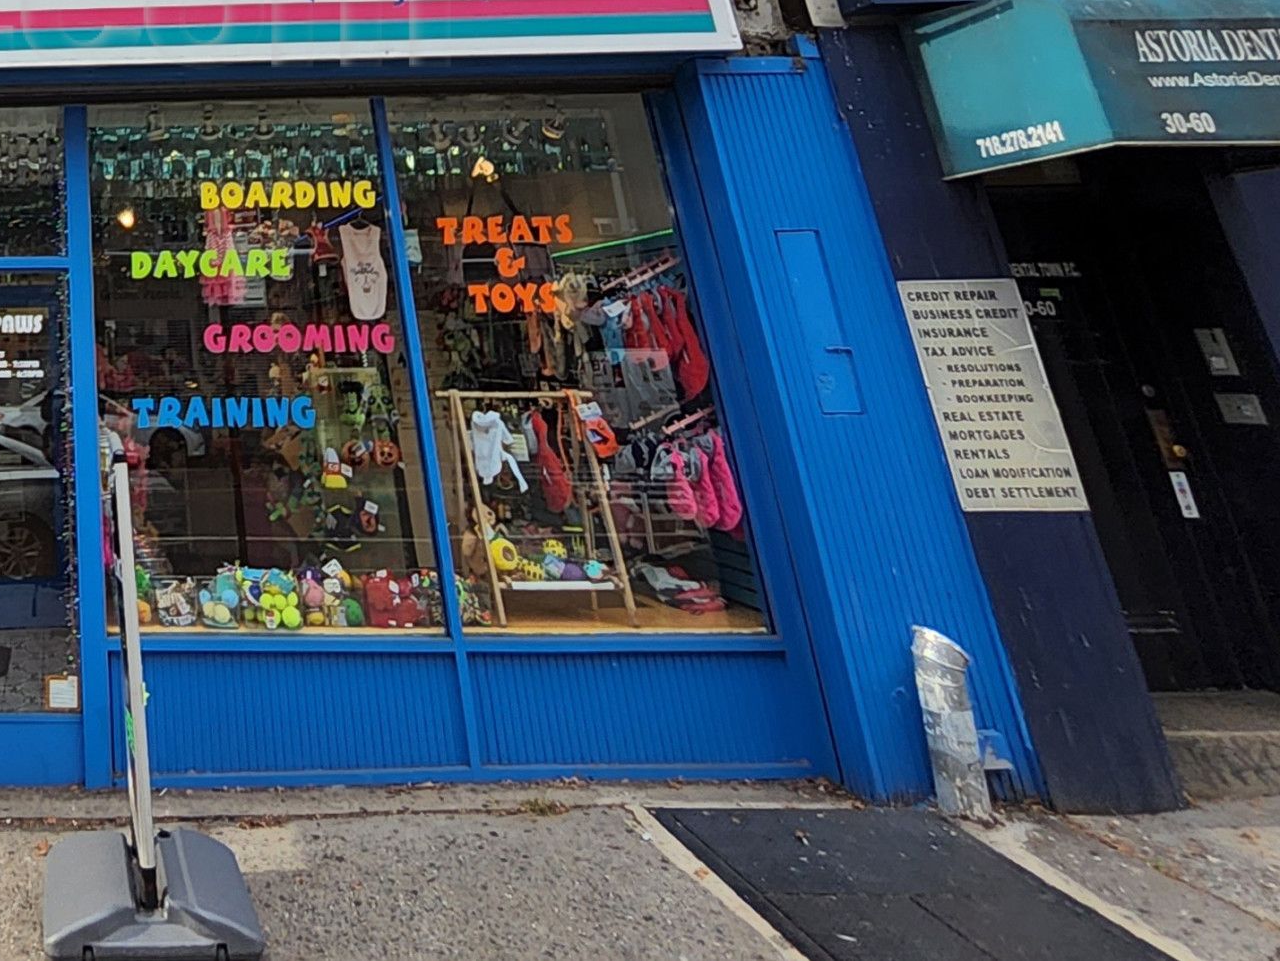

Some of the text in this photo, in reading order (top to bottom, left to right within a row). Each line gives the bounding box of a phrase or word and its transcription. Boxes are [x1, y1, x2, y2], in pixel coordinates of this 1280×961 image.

[1134, 28, 1222, 63] ASTORIA
[1161, 111, 1216, 135] 30-60
[976, 120, 1065, 159] 718.278.2141
[200, 179, 376, 210] BOARDING
[436, 213, 573, 245] TREATS
[130, 248, 291, 280] DAYCARE
[495, 248, 526, 279] &
[468, 281, 558, 314] TOYS
[907, 289, 998, 302] CREDIT REPAIR
[912, 307, 1019, 320] BUSINESS CREDIT
[1023, 300, 1057, 316] 0-60
[203, 322, 396, 354] GROOMING
[917, 326, 989, 339] INSURANCE
[923, 345, 995, 357] TAX ADVICE
[946, 362, 1022, 374] RESOLUTIONS
[950, 377, 1026, 389] PREPARATION
[955, 393, 1034, 405] BOOKKEEPING
[131, 395, 316, 430] TRAINING
[943, 410, 1025, 423] REAL ESTATE
[948, 429, 1026, 441] MORTGAGES
[954, 448, 1010, 460] RENTALS
[960, 466, 1072, 479] LOAN MODIFICATION
[965, 486, 1078, 499] DEBT SETTLEMENT
